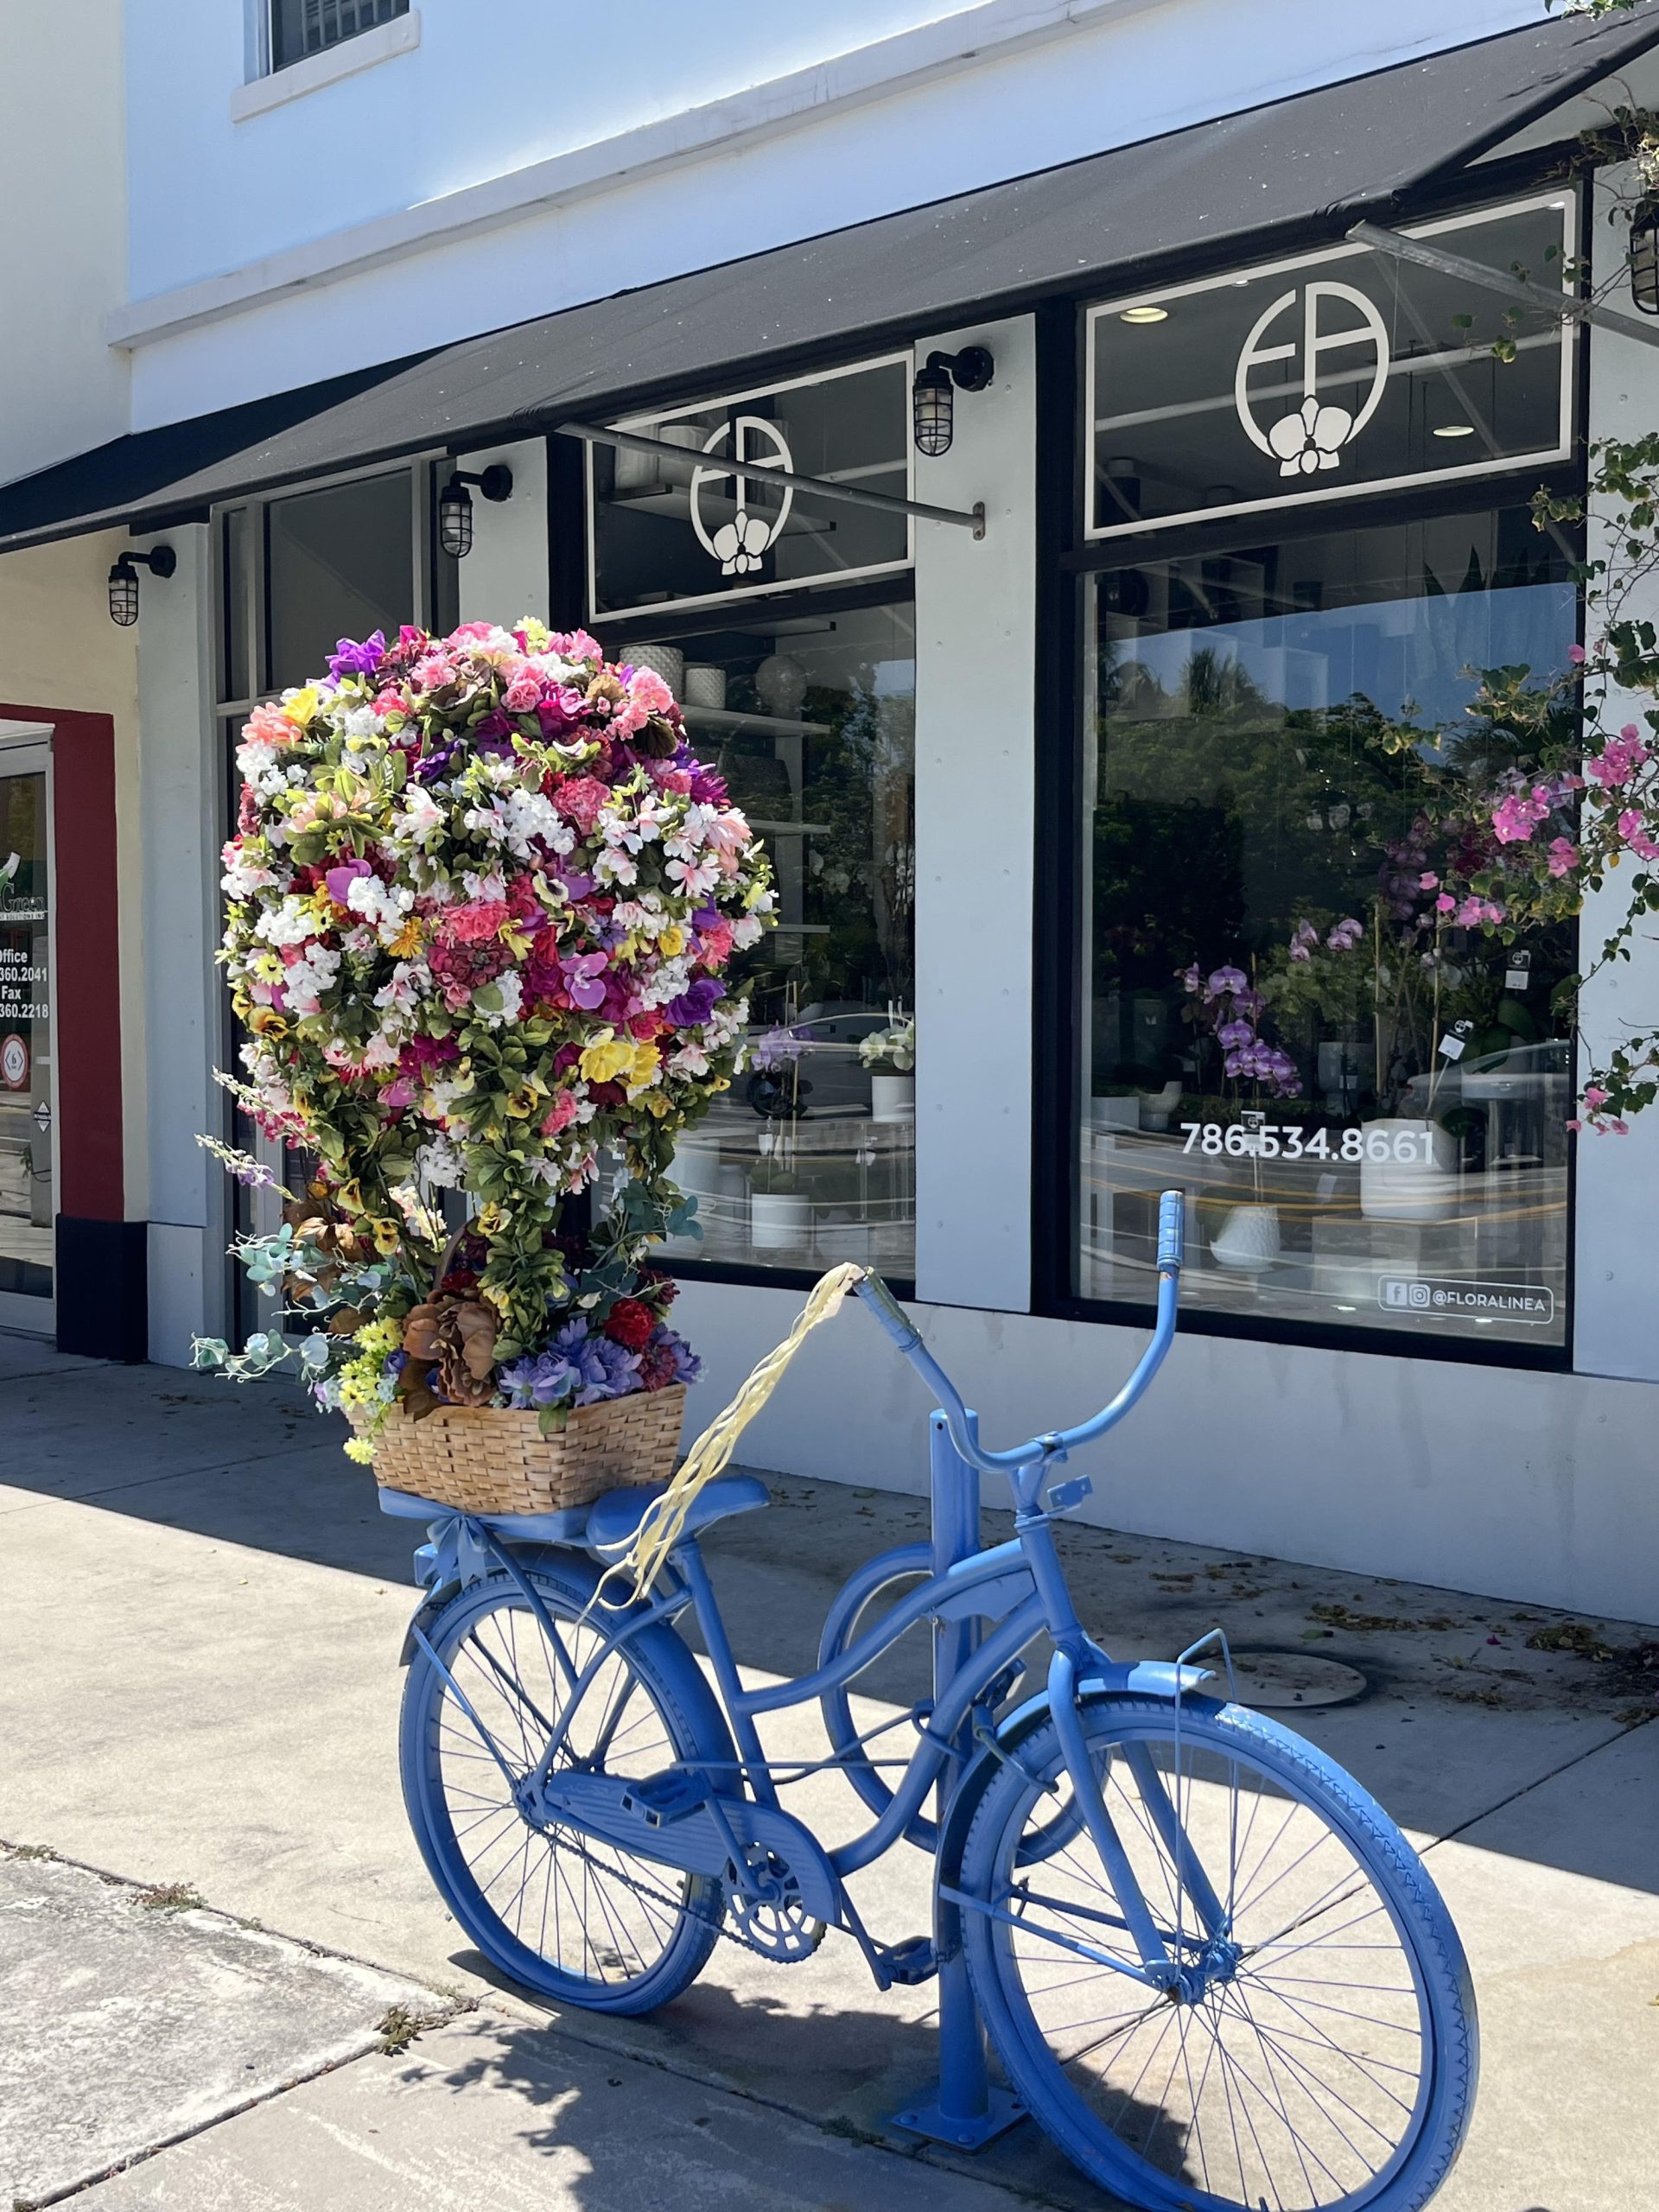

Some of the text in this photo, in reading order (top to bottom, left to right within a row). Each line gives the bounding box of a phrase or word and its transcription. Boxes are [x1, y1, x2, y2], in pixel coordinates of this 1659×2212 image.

[2, 985, 22, 1000] Fax
[1180, 1123, 1433, 1165] 786.534.8661
[1432, 1289, 1547, 1312] @FLORALINEA
